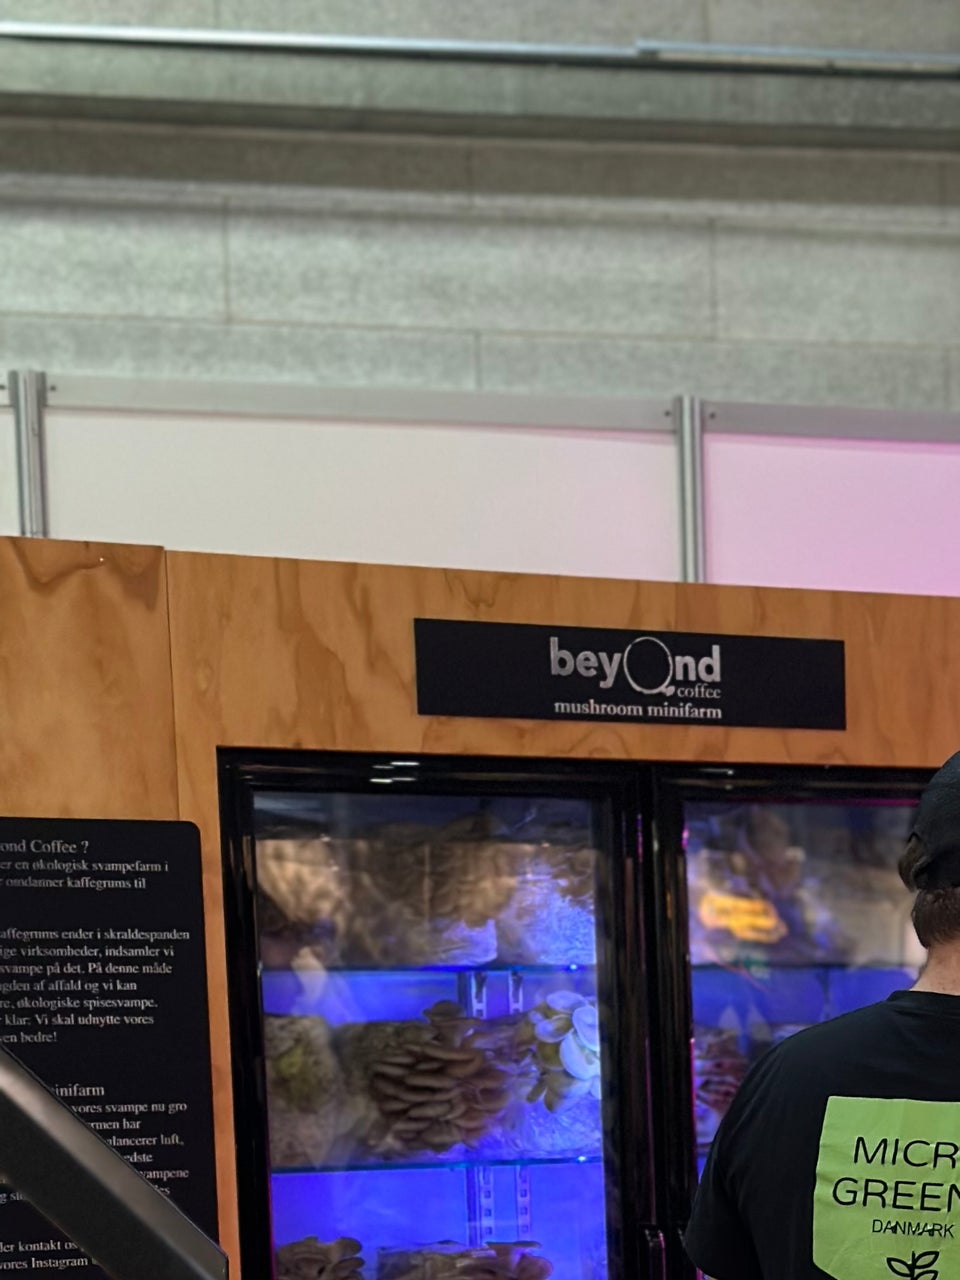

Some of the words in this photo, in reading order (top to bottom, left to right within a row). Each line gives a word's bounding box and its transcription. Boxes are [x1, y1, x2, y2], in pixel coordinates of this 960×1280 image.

[677, 683, 722, 699] coffee
[554, 699, 643, 716] mushroom
[647, 702, 722, 719] minifarm
[30, 839, 77, 853] Coffee
[15, 861, 29, 870] en
[32, 859, 88, 873] økologisk
[92, 861, 161, 874] svampefarm
[6, 876, 63, 887] omdanner
[67, 877, 131, 891] kaffegrums
[134, 878, 147, 889] til
[61, 928, 94, 940] ender
[104, 928, 190, 943] skraldespanden
[20, 945, 102, 958] virksomheder,
[105, 945, 160, 957] indsamler
[163, 945, 174, 957] vi
[46, 962, 60, 976] på
[63, 962, 85, 974] det.
[88, 962, 102, 974] På
[105, 962, 139, 974] denne
[142, 962, 173, 974] måde
[33, 980, 45, 991] af
[48, 980, 82, 992] affald
[84, 982, 99, 993] og
[102, 979, 113, 990] vi
[116, 980, 137, 990] kan
[17, 996, 80, 1011] økologiske
[83, 996, 158, 1011] spisesvampe.
[35, 1013, 48, 1025] Vi
[51, 1013, 74, 1025] skal
[78, 1013, 120, 1028] udnytte
[123, 1015, 154, 1025] vores
[20, 1031, 57, 1043] bedre!
[52, 1084, 105, 1097] inifarm
[105, 1103, 148, 1115] svampe
[151, 1102, 165, 1112] nu
[168, 1102, 187, 1115] gro
[123, 1118, 141, 1129] har
[872, 1219, 954, 1238] DANMARK
[18, 1240, 61, 1252] kontakt
[31, 1257, 88, 1270] Instagram
